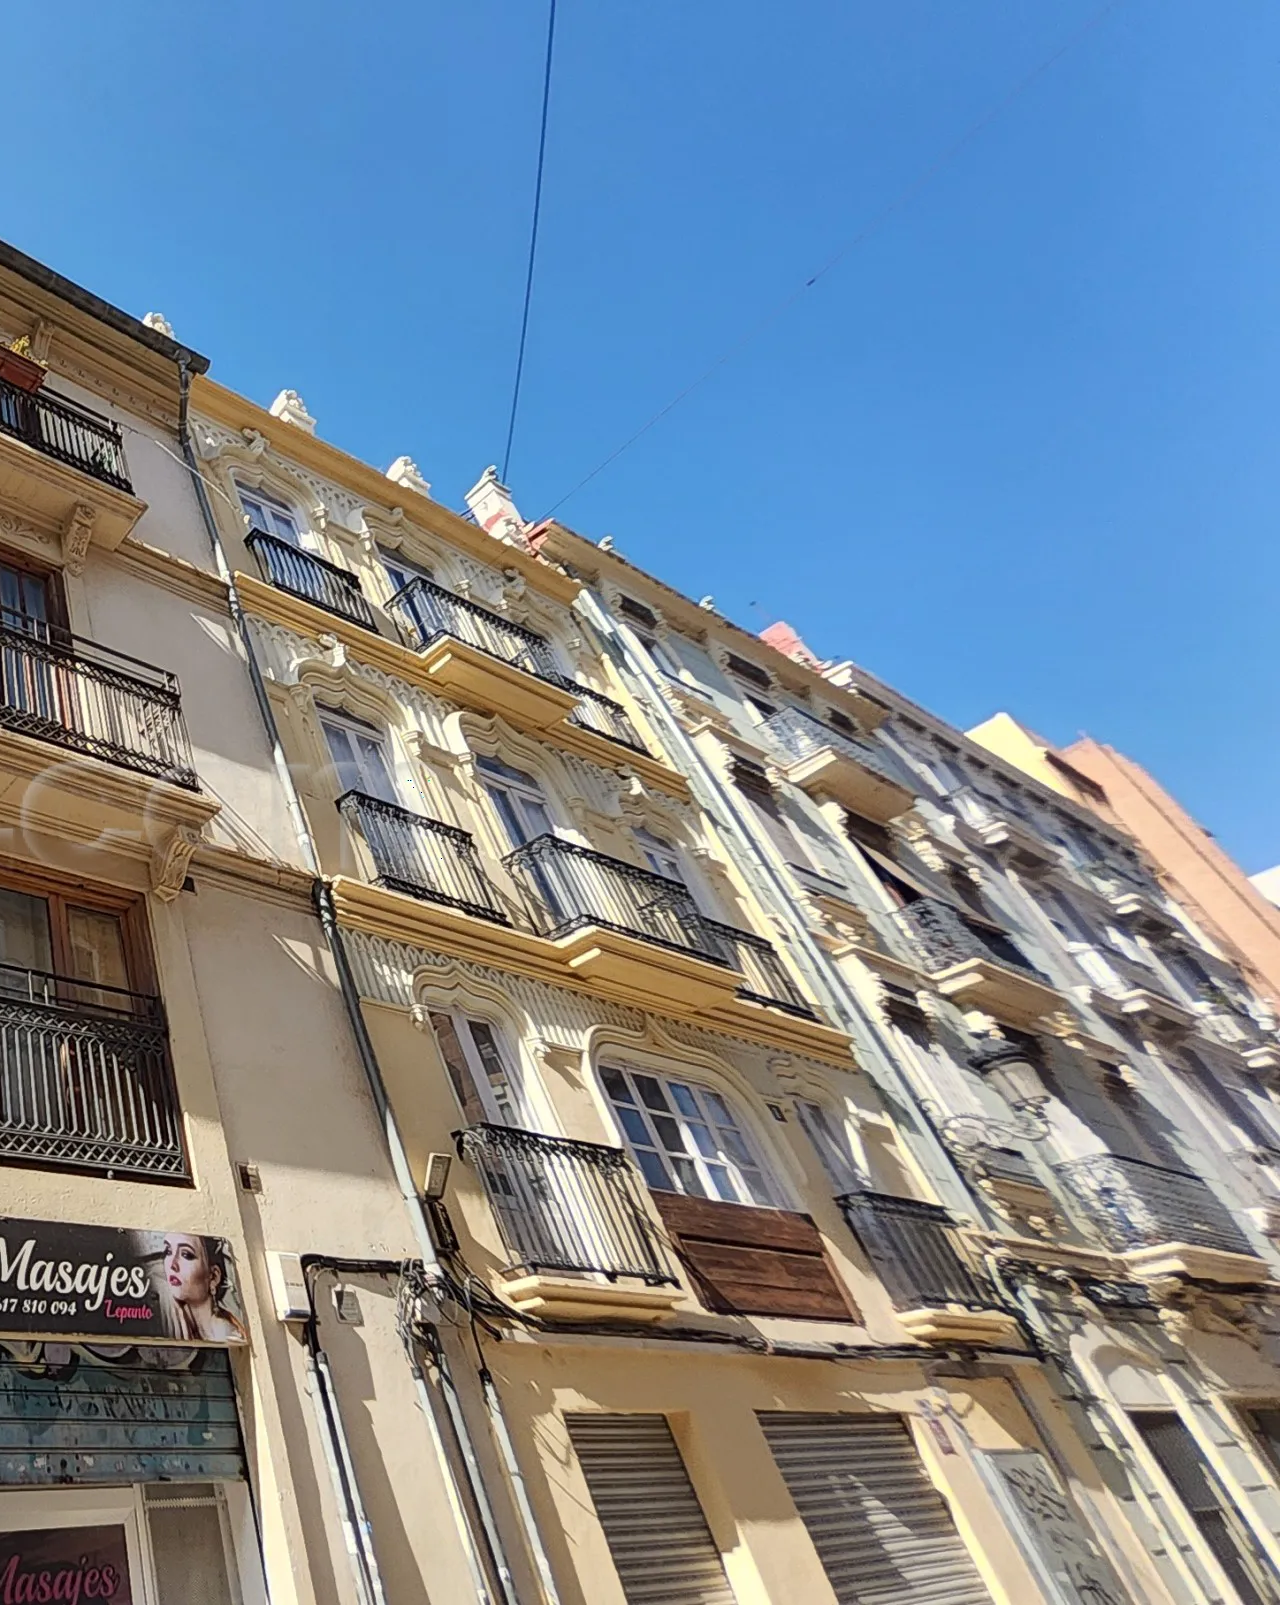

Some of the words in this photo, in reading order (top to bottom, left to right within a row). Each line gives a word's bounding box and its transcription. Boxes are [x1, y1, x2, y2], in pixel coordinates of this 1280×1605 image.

[22, 1299, 47, 1314] 810
[51, 1301, 77, 1316] 094
[104, 1299, 153, 1324] Lepanto
